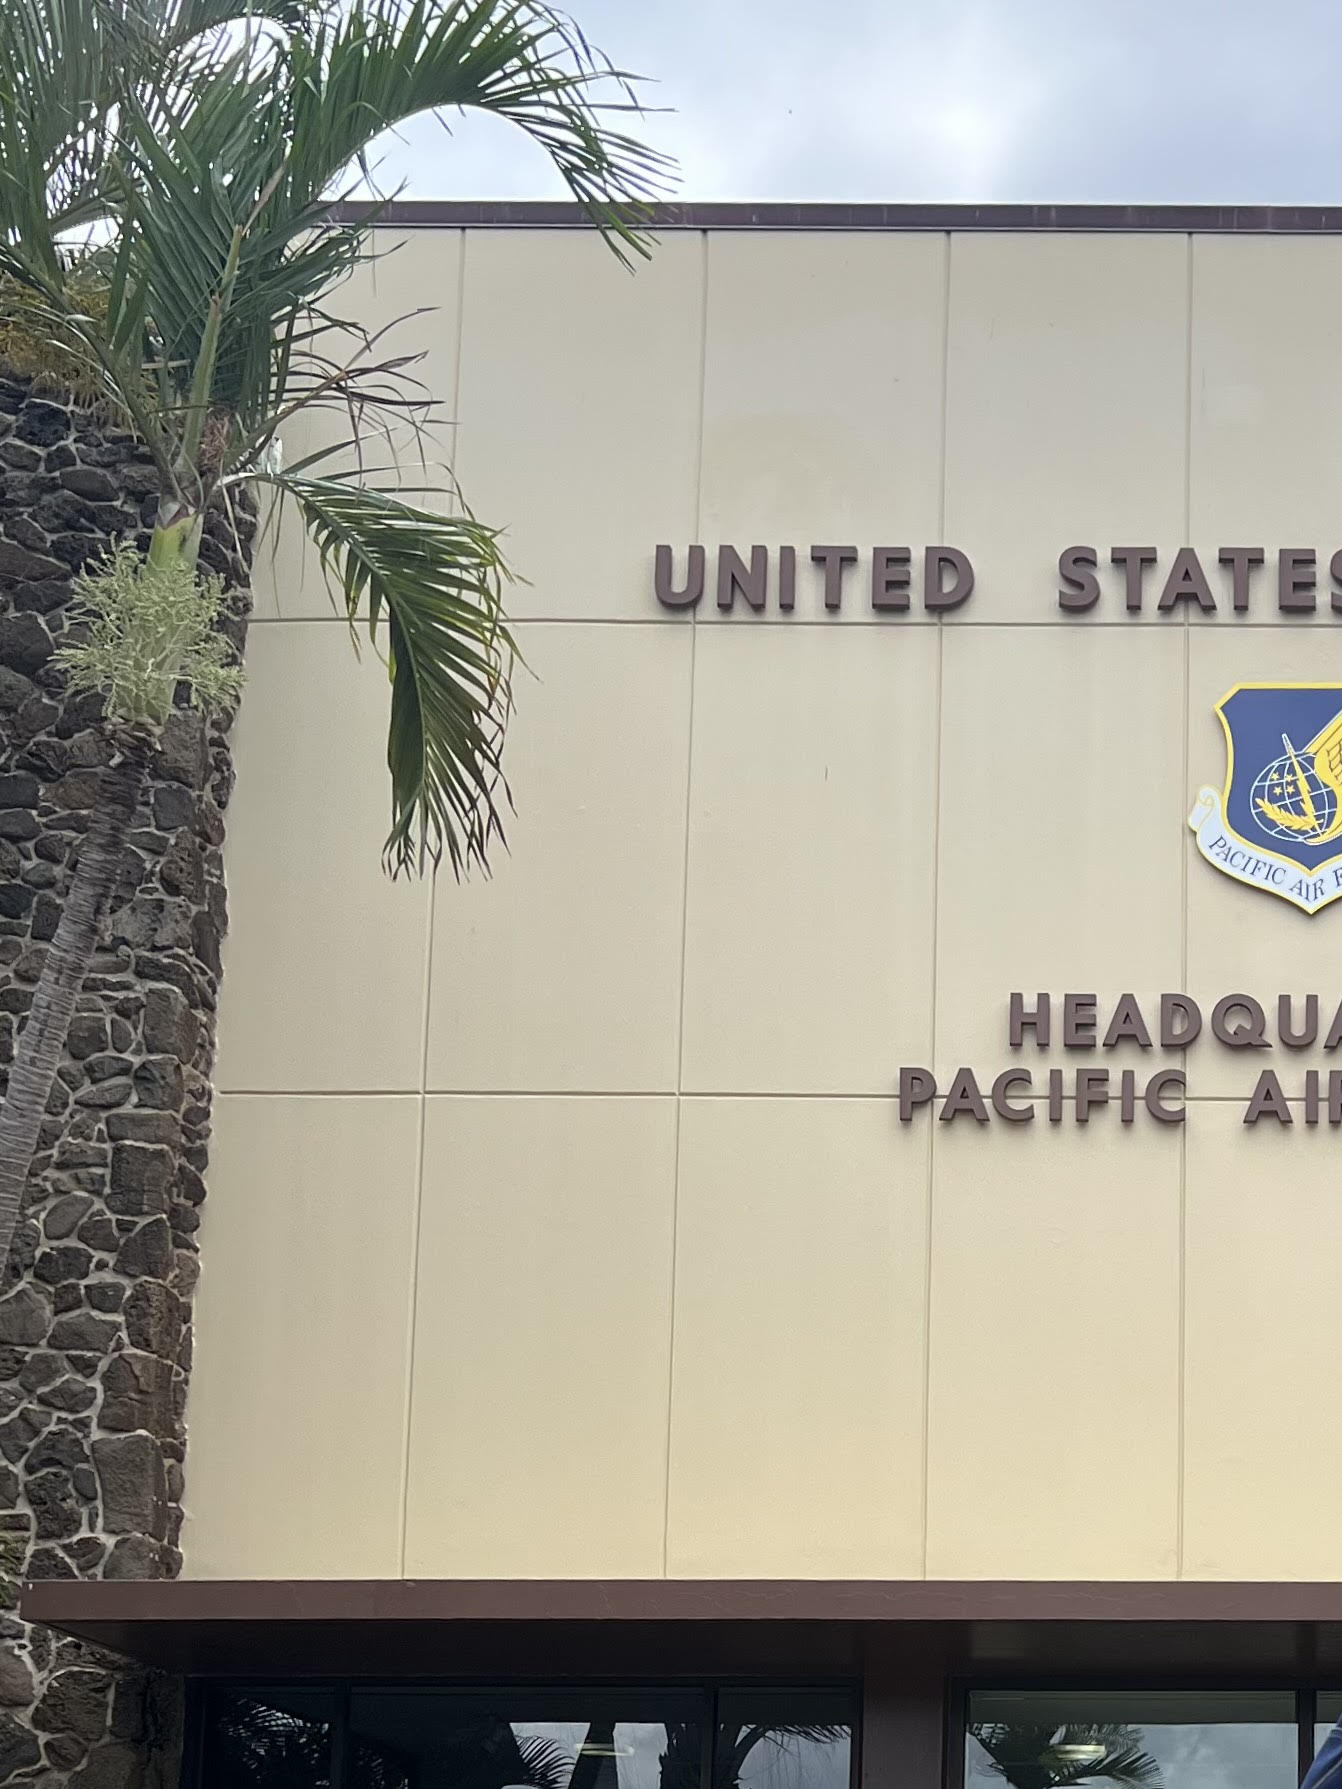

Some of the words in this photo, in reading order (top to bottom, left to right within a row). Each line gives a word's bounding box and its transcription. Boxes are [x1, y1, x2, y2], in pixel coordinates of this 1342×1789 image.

[654, 544, 976, 613] UNITED
[1208, 835, 1287, 886] PACIFIC
[1288, 878, 1326, 903] AIR
[898, 1067, 1189, 1123] PACIFIC
